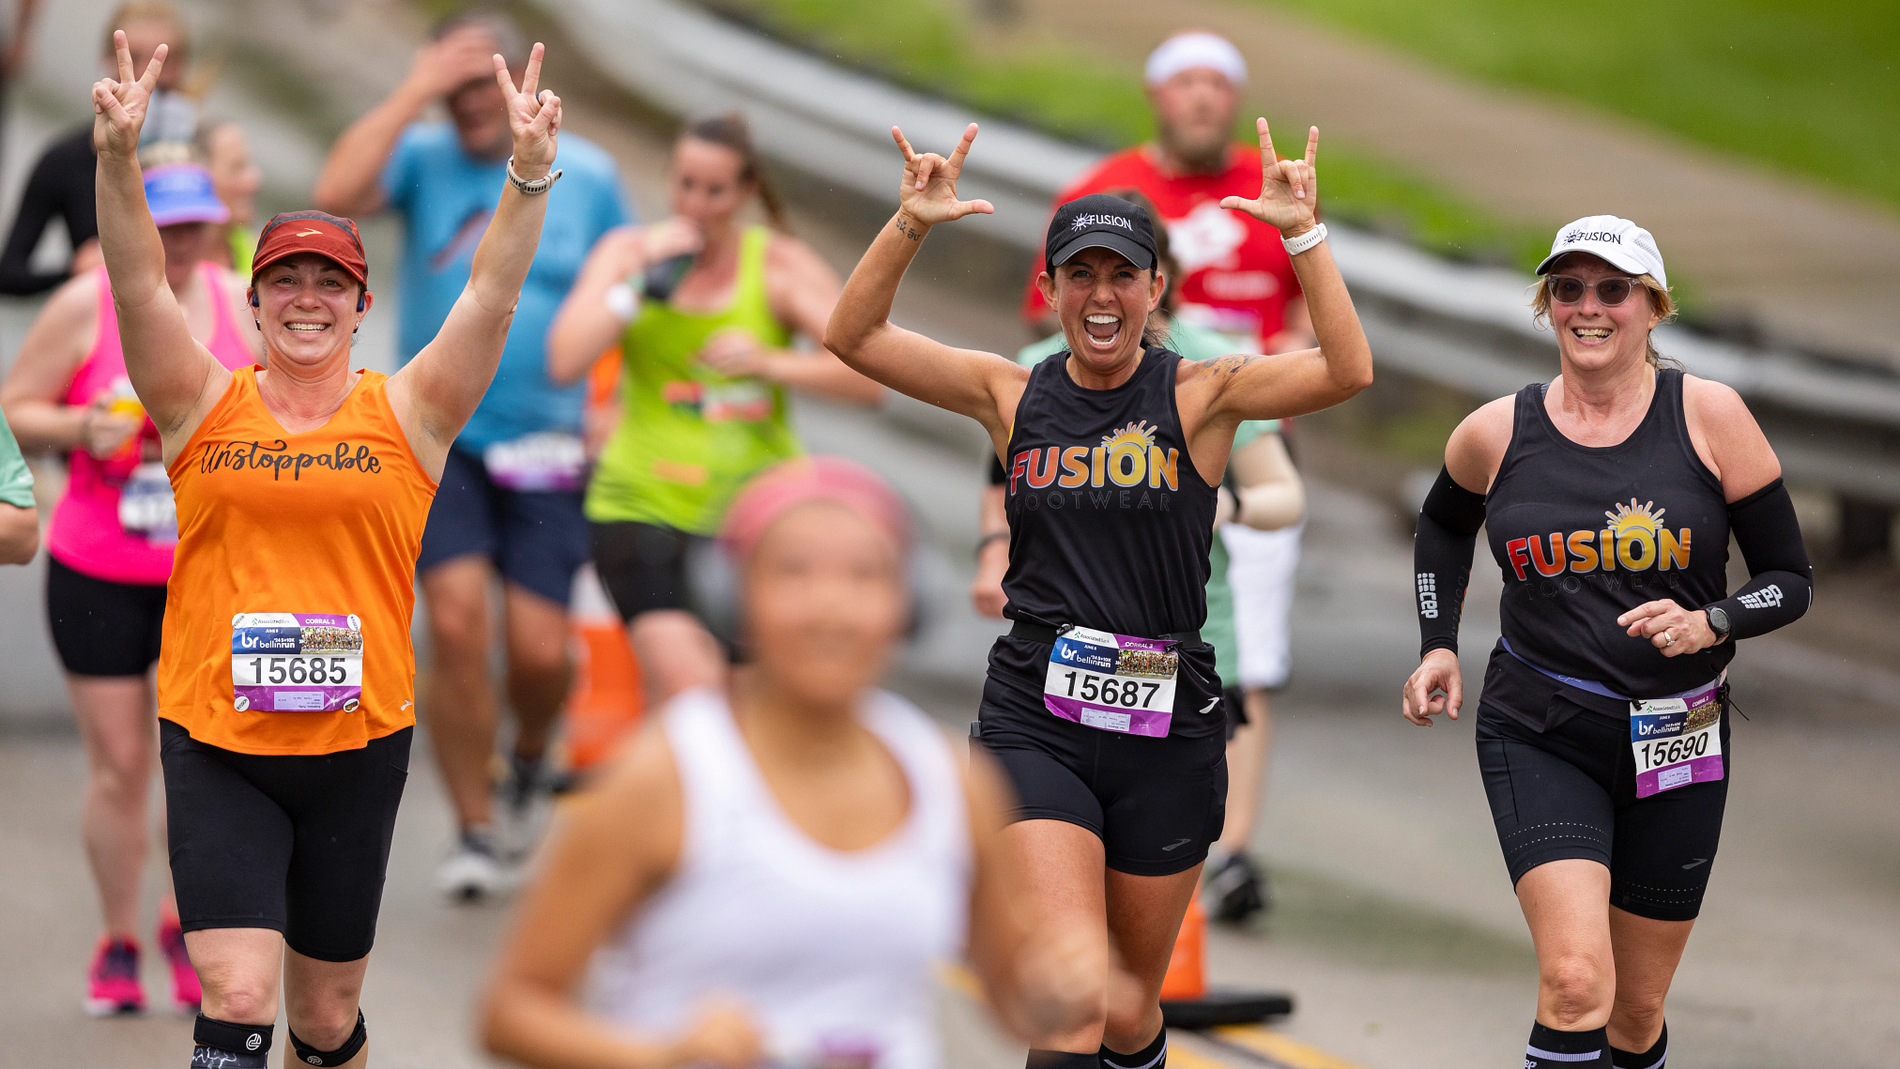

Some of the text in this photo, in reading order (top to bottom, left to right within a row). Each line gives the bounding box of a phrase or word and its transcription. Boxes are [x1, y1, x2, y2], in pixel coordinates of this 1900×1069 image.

[1088, 214, 1134, 232] FUSION
[1578, 231, 1622, 245] FUSION
[201, 439, 382, 481] Unstoppable
[1010, 441, 1180, 497] FUSION
[1015, 489, 1171, 515] OOTWEAR
[1505, 526, 1692, 582] FUSION
[1419, 592, 1439, 619] cep
[1751, 584, 1784, 608] cep
[259, 640, 295, 649] bellinrun
[1124, 641, 1148, 649] CORRAL
[249, 657, 347, 684] 15685
[1076, 654, 1111, 668] bellinrun
[1064, 671, 1161, 708] 15687
[1641, 731, 1709, 769] 15690
[1524, 1058, 1538, 1069] ep
